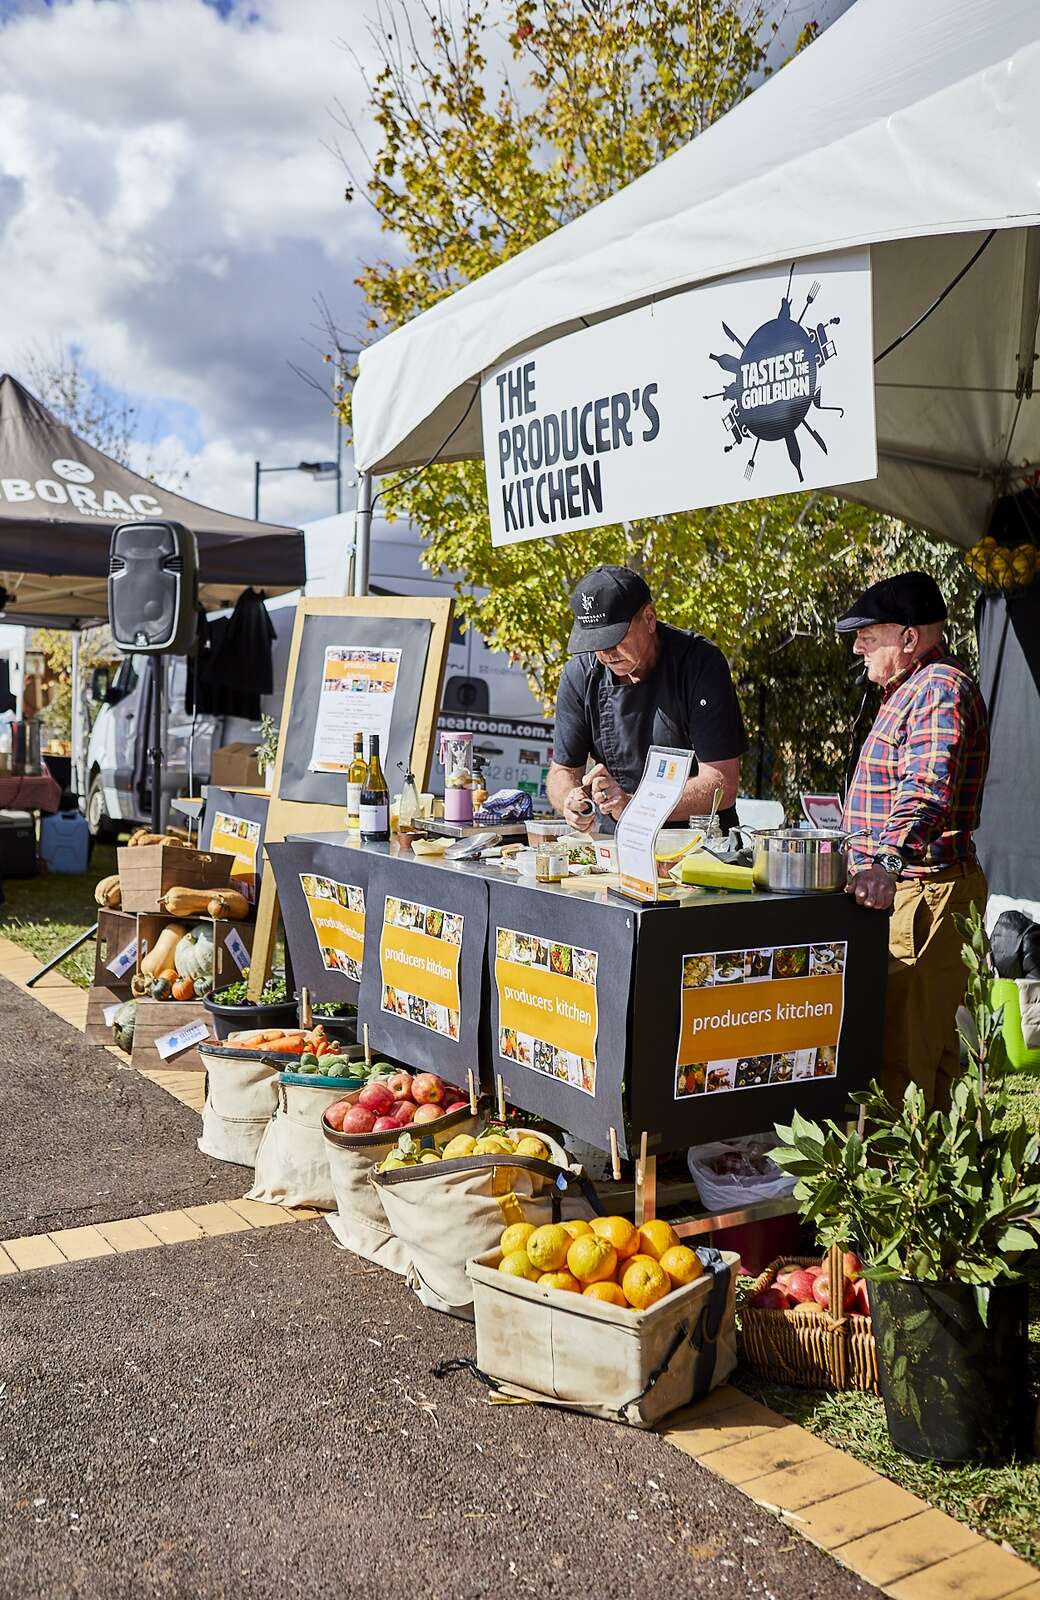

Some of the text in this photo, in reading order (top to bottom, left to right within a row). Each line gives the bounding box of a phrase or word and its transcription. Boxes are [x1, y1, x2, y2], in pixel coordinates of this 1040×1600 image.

[740, 349, 806, 389] TASTES OF
[794, 360, 810, 378] THE
[496, 361, 537, 423] THE
[740, 374, 811, 410] GOULBURN
[497, 382, 661, 480] PRODUCER'S
[0, 478, 163, 517] BORAC
[501, 460, 604, 533] KITCHEN
[384, 946, 454, 982] producers kitchen
[504, 984, 593, 1025] producers kitchen
[692, 1001, 833, 1035] producers kitchen
